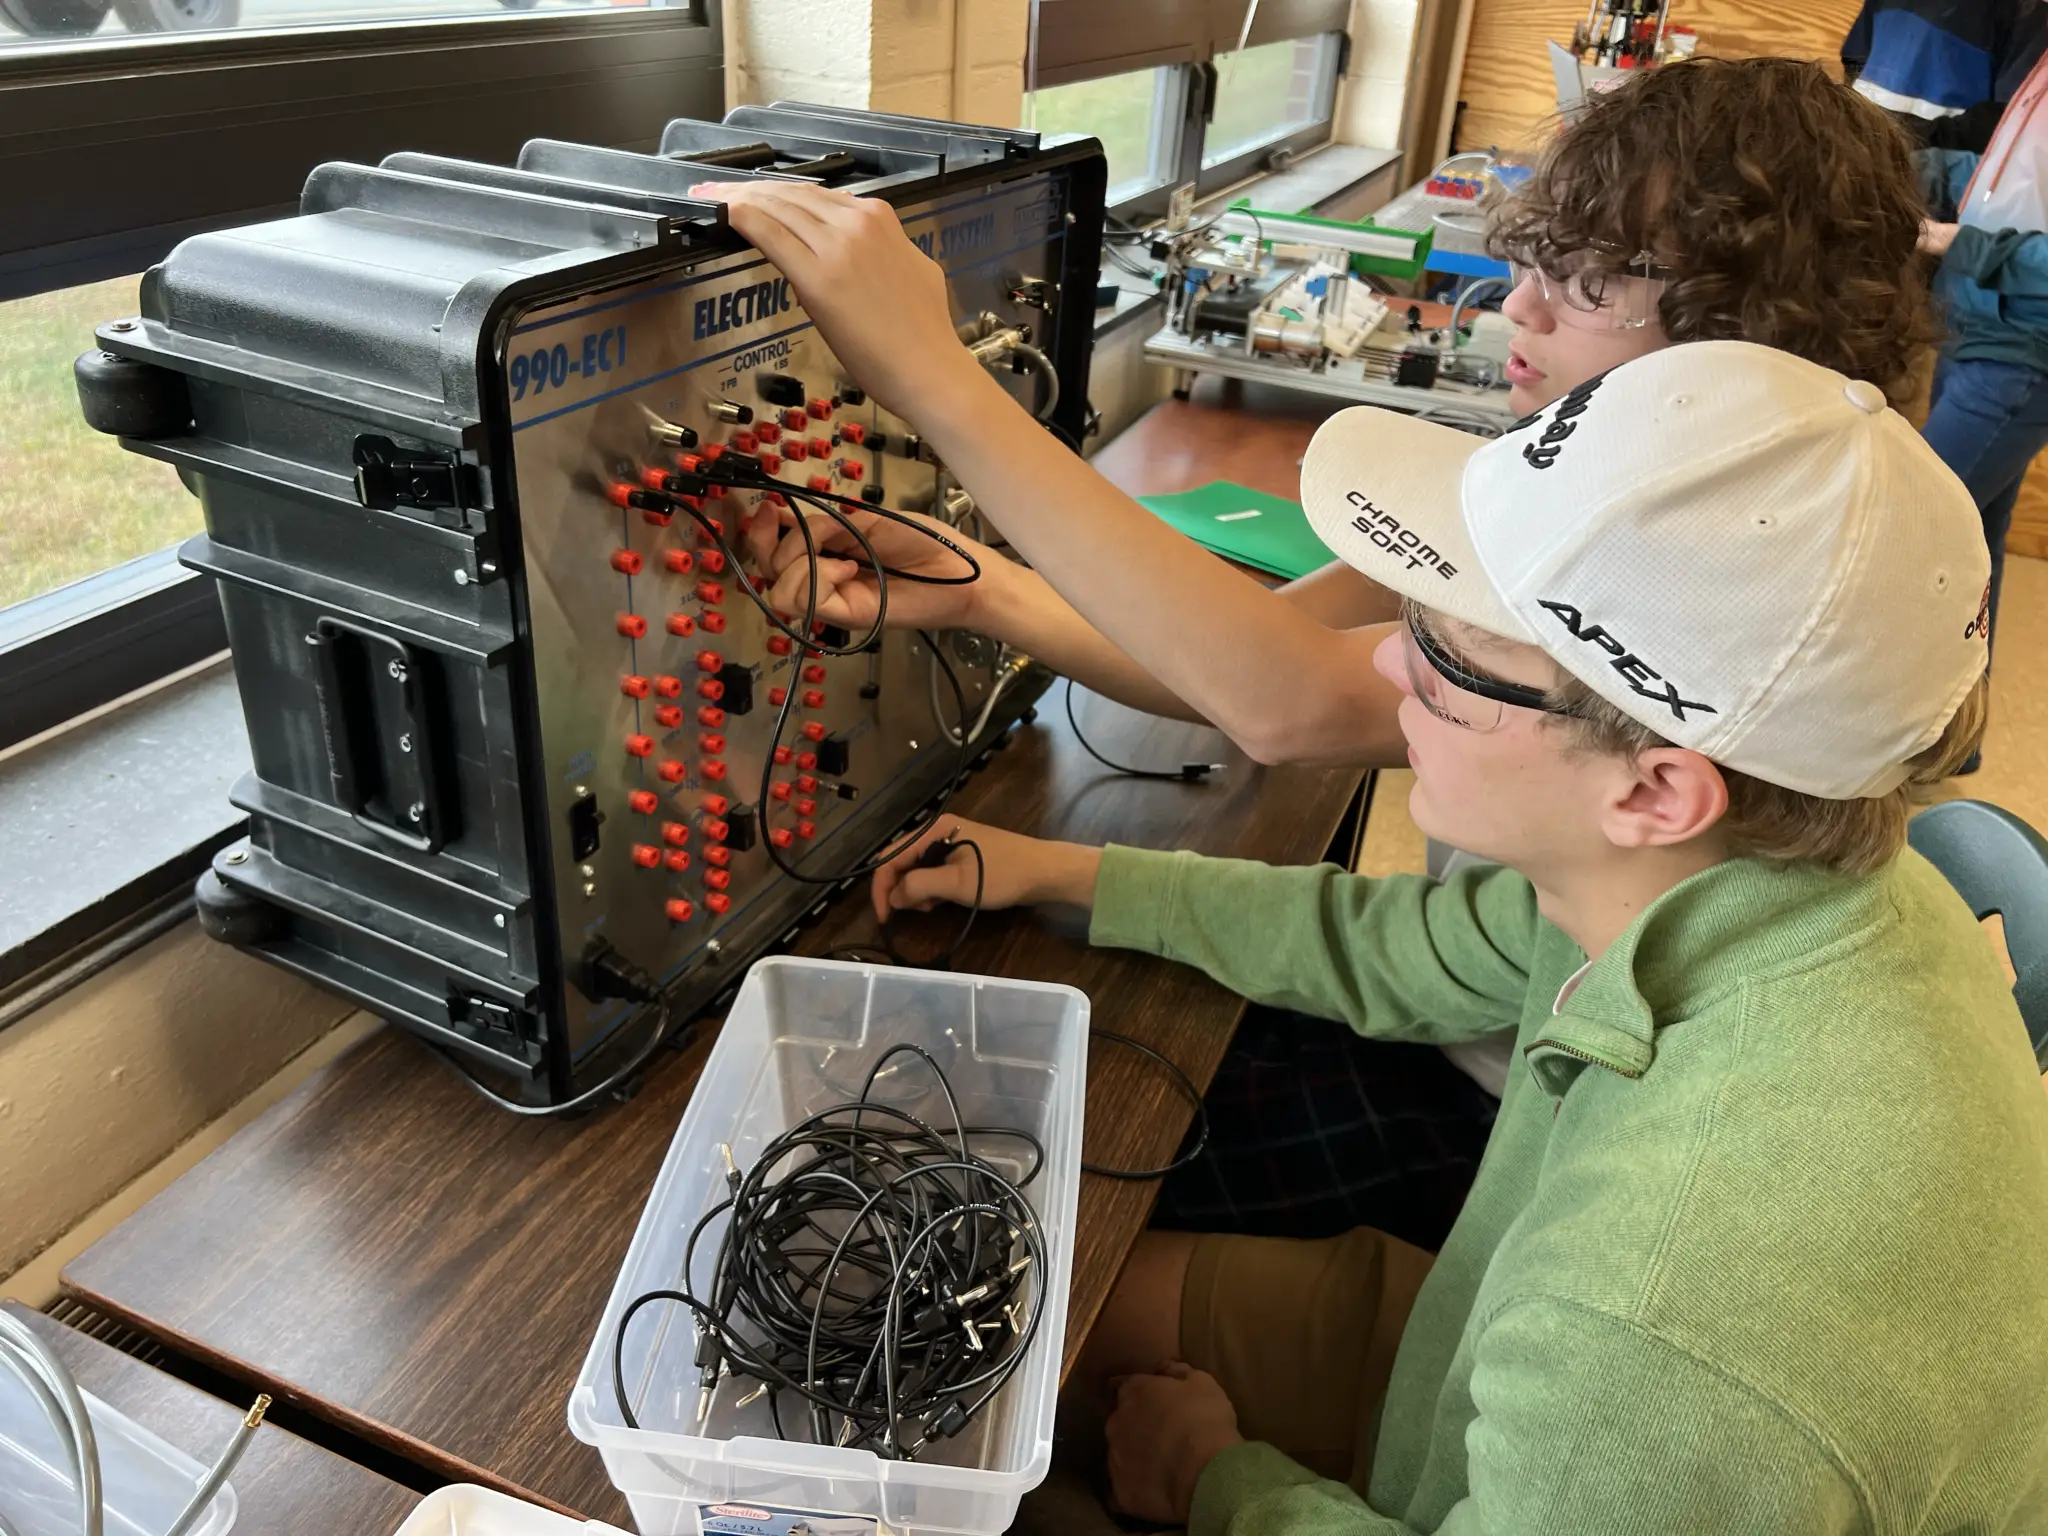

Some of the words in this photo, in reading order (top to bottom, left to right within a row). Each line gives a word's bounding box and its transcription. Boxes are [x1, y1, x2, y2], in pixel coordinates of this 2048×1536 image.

[694, 277, 801, 342] ELECTRIC
[939, 212, 995, 260] SYSTEM
[509, 325, 627, 402] 990-EC1
[734, 339, 792, 373] CONTROL
[1346, 491, 1458, 580] CHROME
[1351, 516, 1423, 570] SOFT
[1536, 599, 1718, 722] APEX
[715, 1506, 767, 1519] Sterilite
